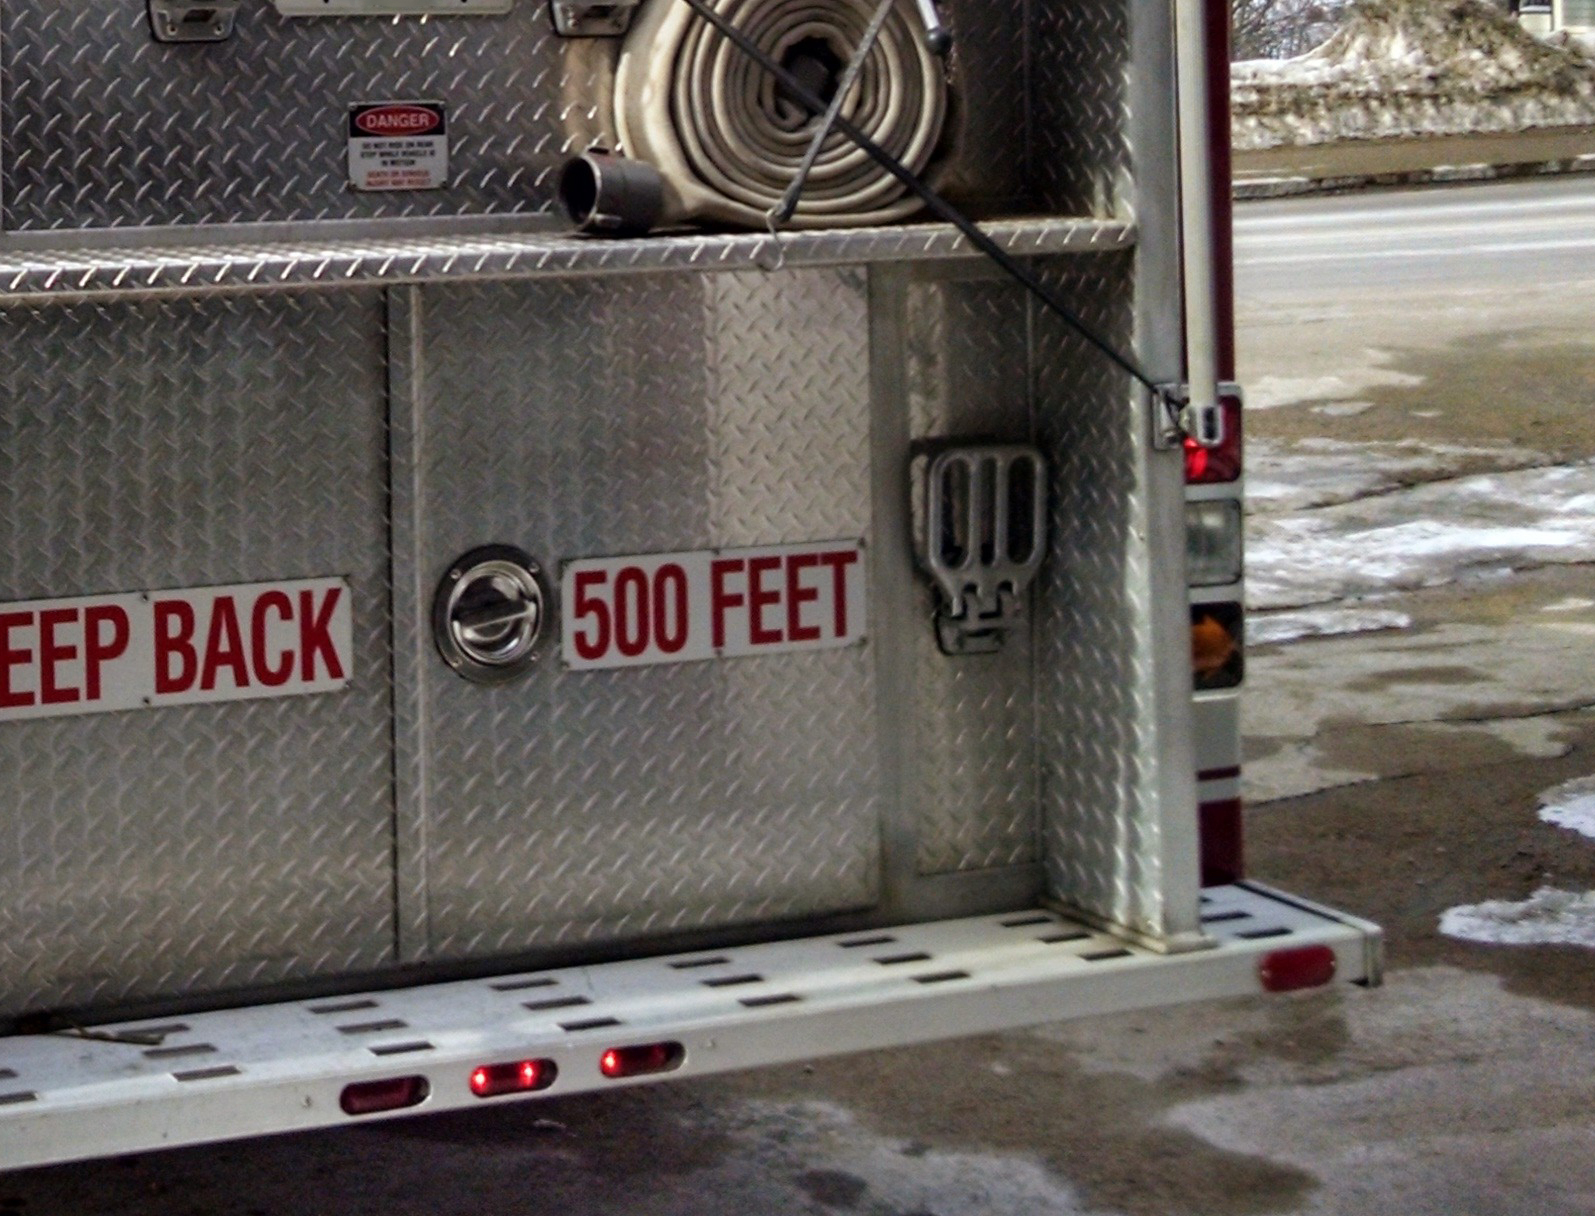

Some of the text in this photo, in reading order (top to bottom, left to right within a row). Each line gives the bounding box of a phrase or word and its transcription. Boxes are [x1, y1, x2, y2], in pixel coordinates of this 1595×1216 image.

[365, 113, 430, 128] DANGER
[153, 587, 345, 695] BACK
[573, 550, 858, 661] 500 FEET
